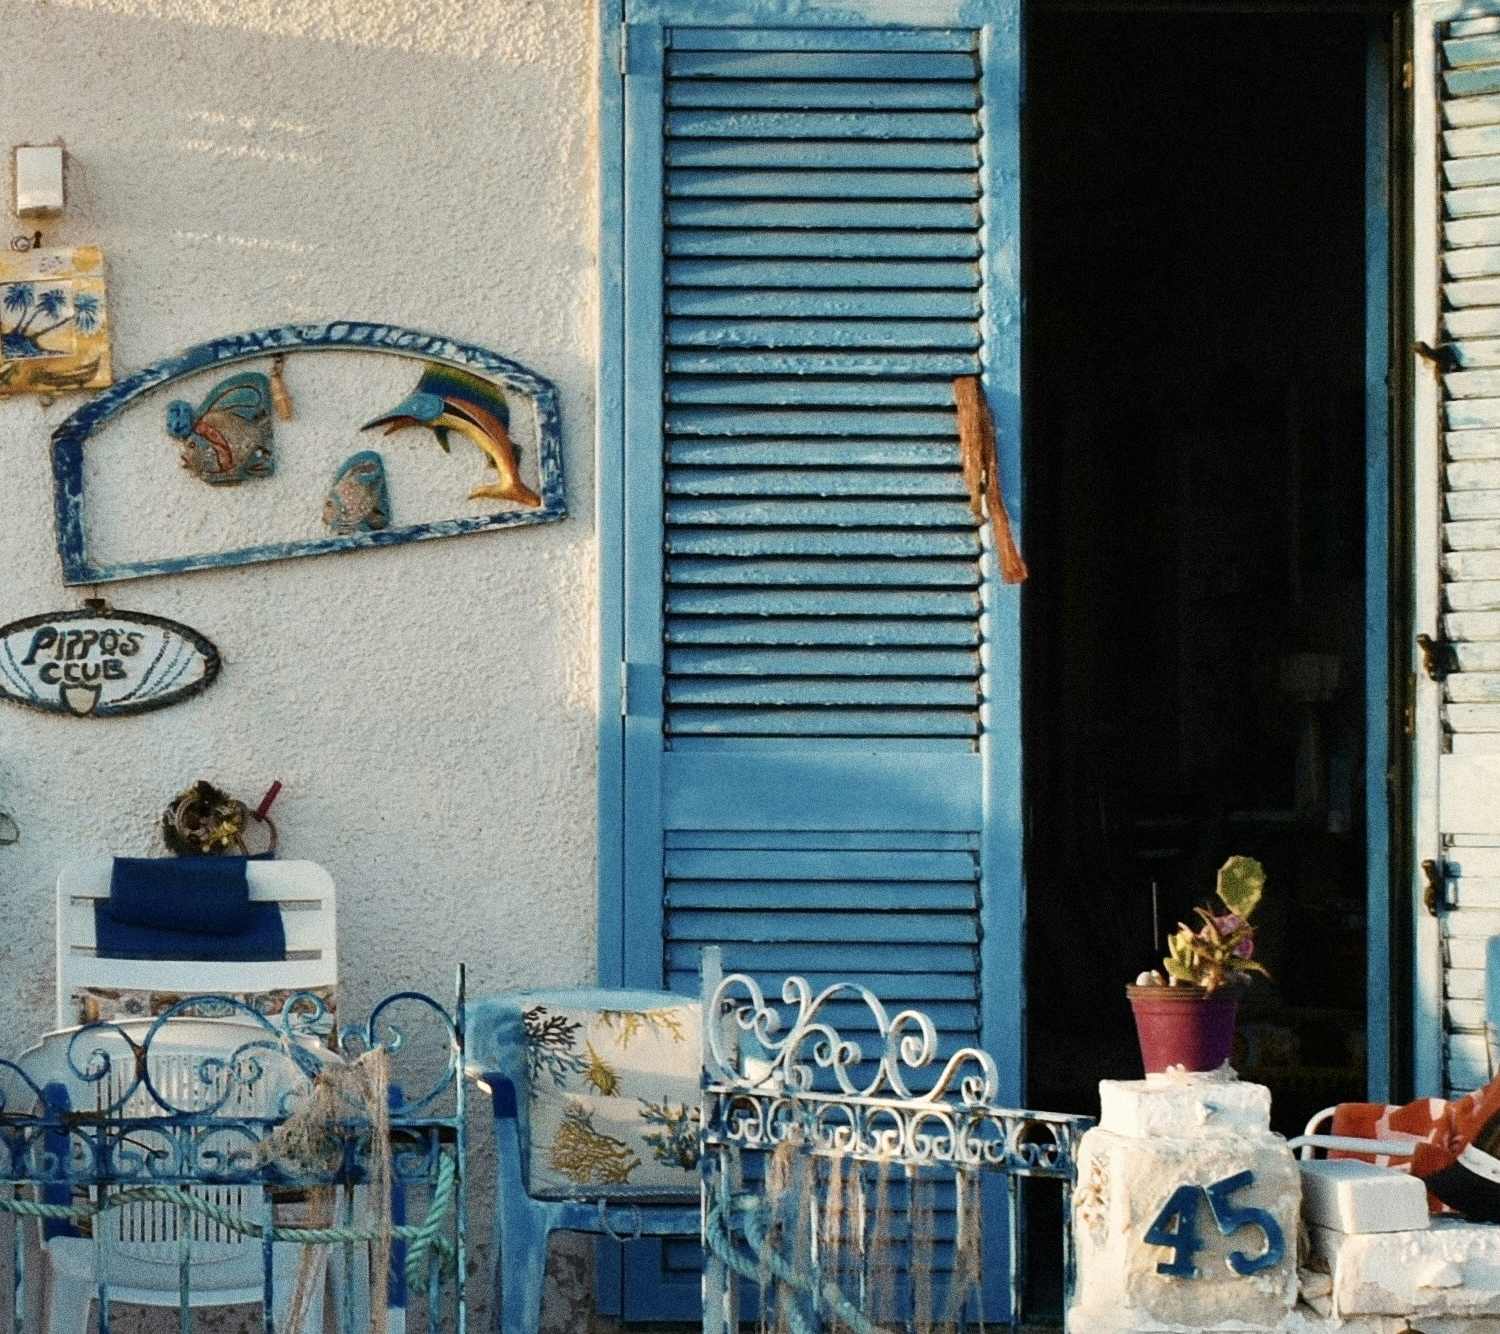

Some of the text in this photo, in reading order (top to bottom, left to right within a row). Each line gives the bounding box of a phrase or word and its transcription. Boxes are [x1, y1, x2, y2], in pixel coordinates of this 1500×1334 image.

[21, 626, 145, 665] PIPPO'S
[38, 658, 127, 685] CLUB
[1142, 1169, 1287, 1279] 45
